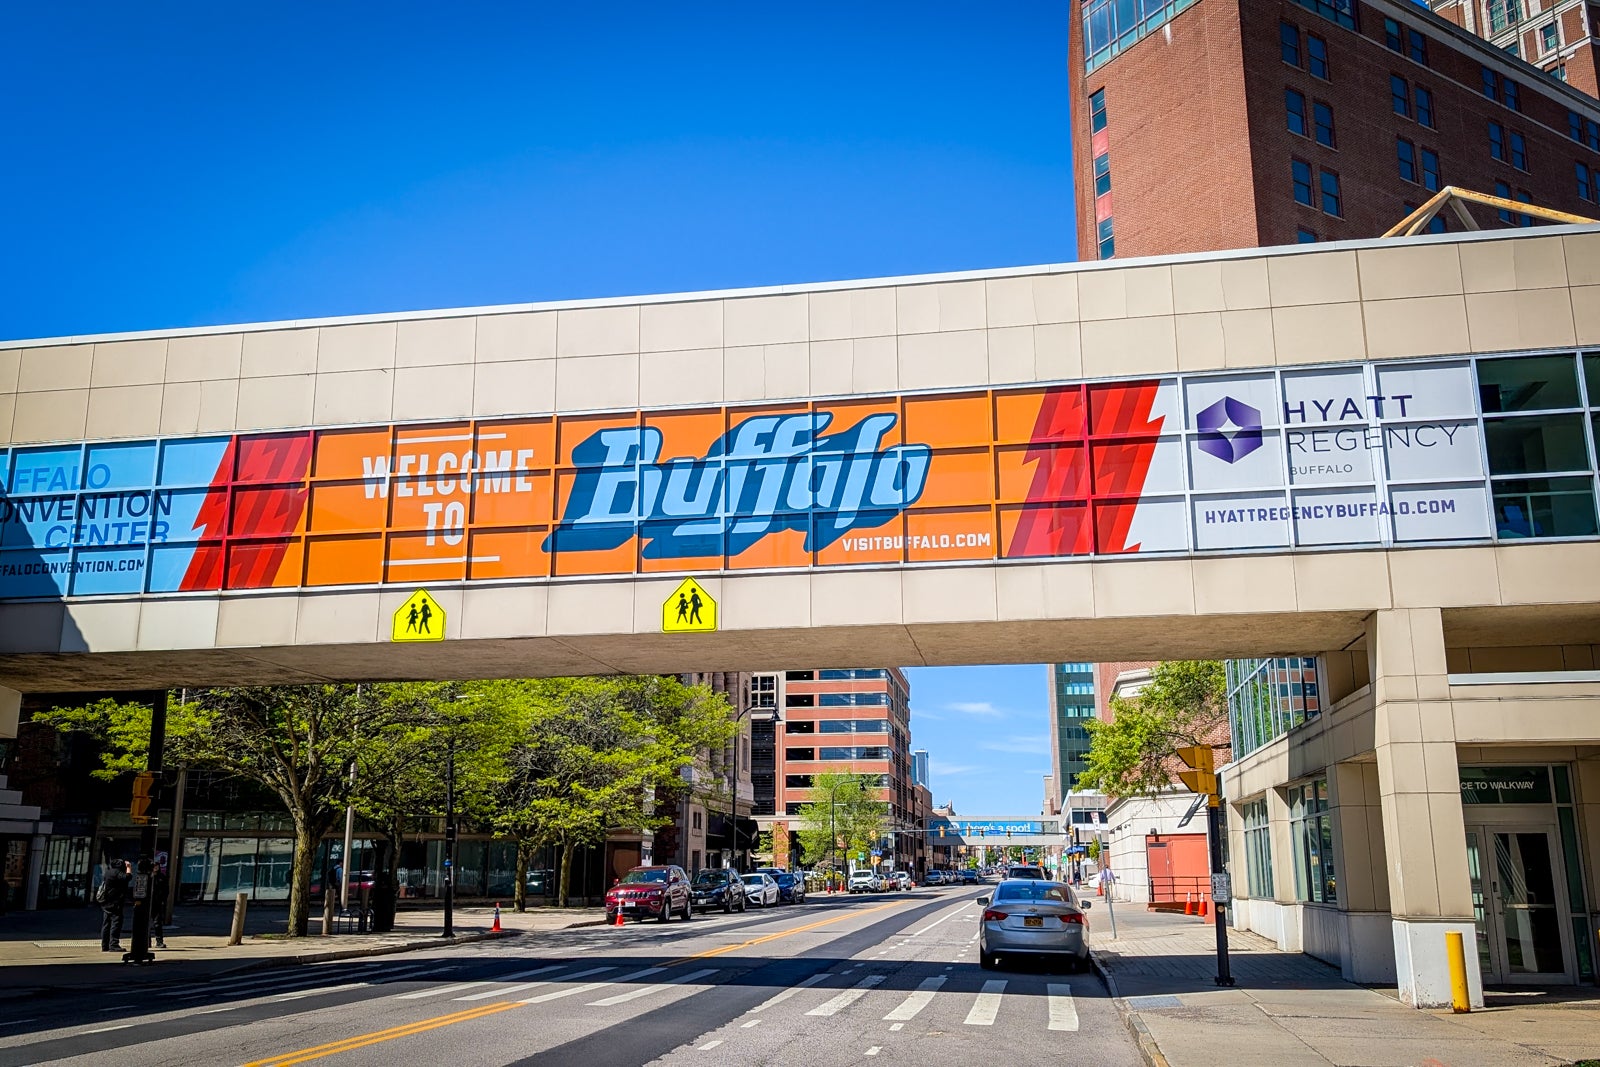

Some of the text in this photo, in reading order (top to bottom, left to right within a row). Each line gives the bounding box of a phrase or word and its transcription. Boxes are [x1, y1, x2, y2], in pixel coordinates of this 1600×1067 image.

[1284, 394, 1413, 424] HYATT
[1288, 422, 1460, 454] REGENCY
[362, 449, 534, 499] WELCOME
[565, 411, 932, 541] Buffalo
[1290, 463, 1353, 476] BUFFALO
[423, 501, 465, 546] TO
[1205, 498, 1456, 525] HYATTREGENCYBUFFALO.COM
[44, 520, 170, 549] CENTER
[842, 532, 991, 553] VISITBUFFALO.COM
[1474, 781, 1488, 790] TO
[1489, 780, 1535, 790] WALKWAY
